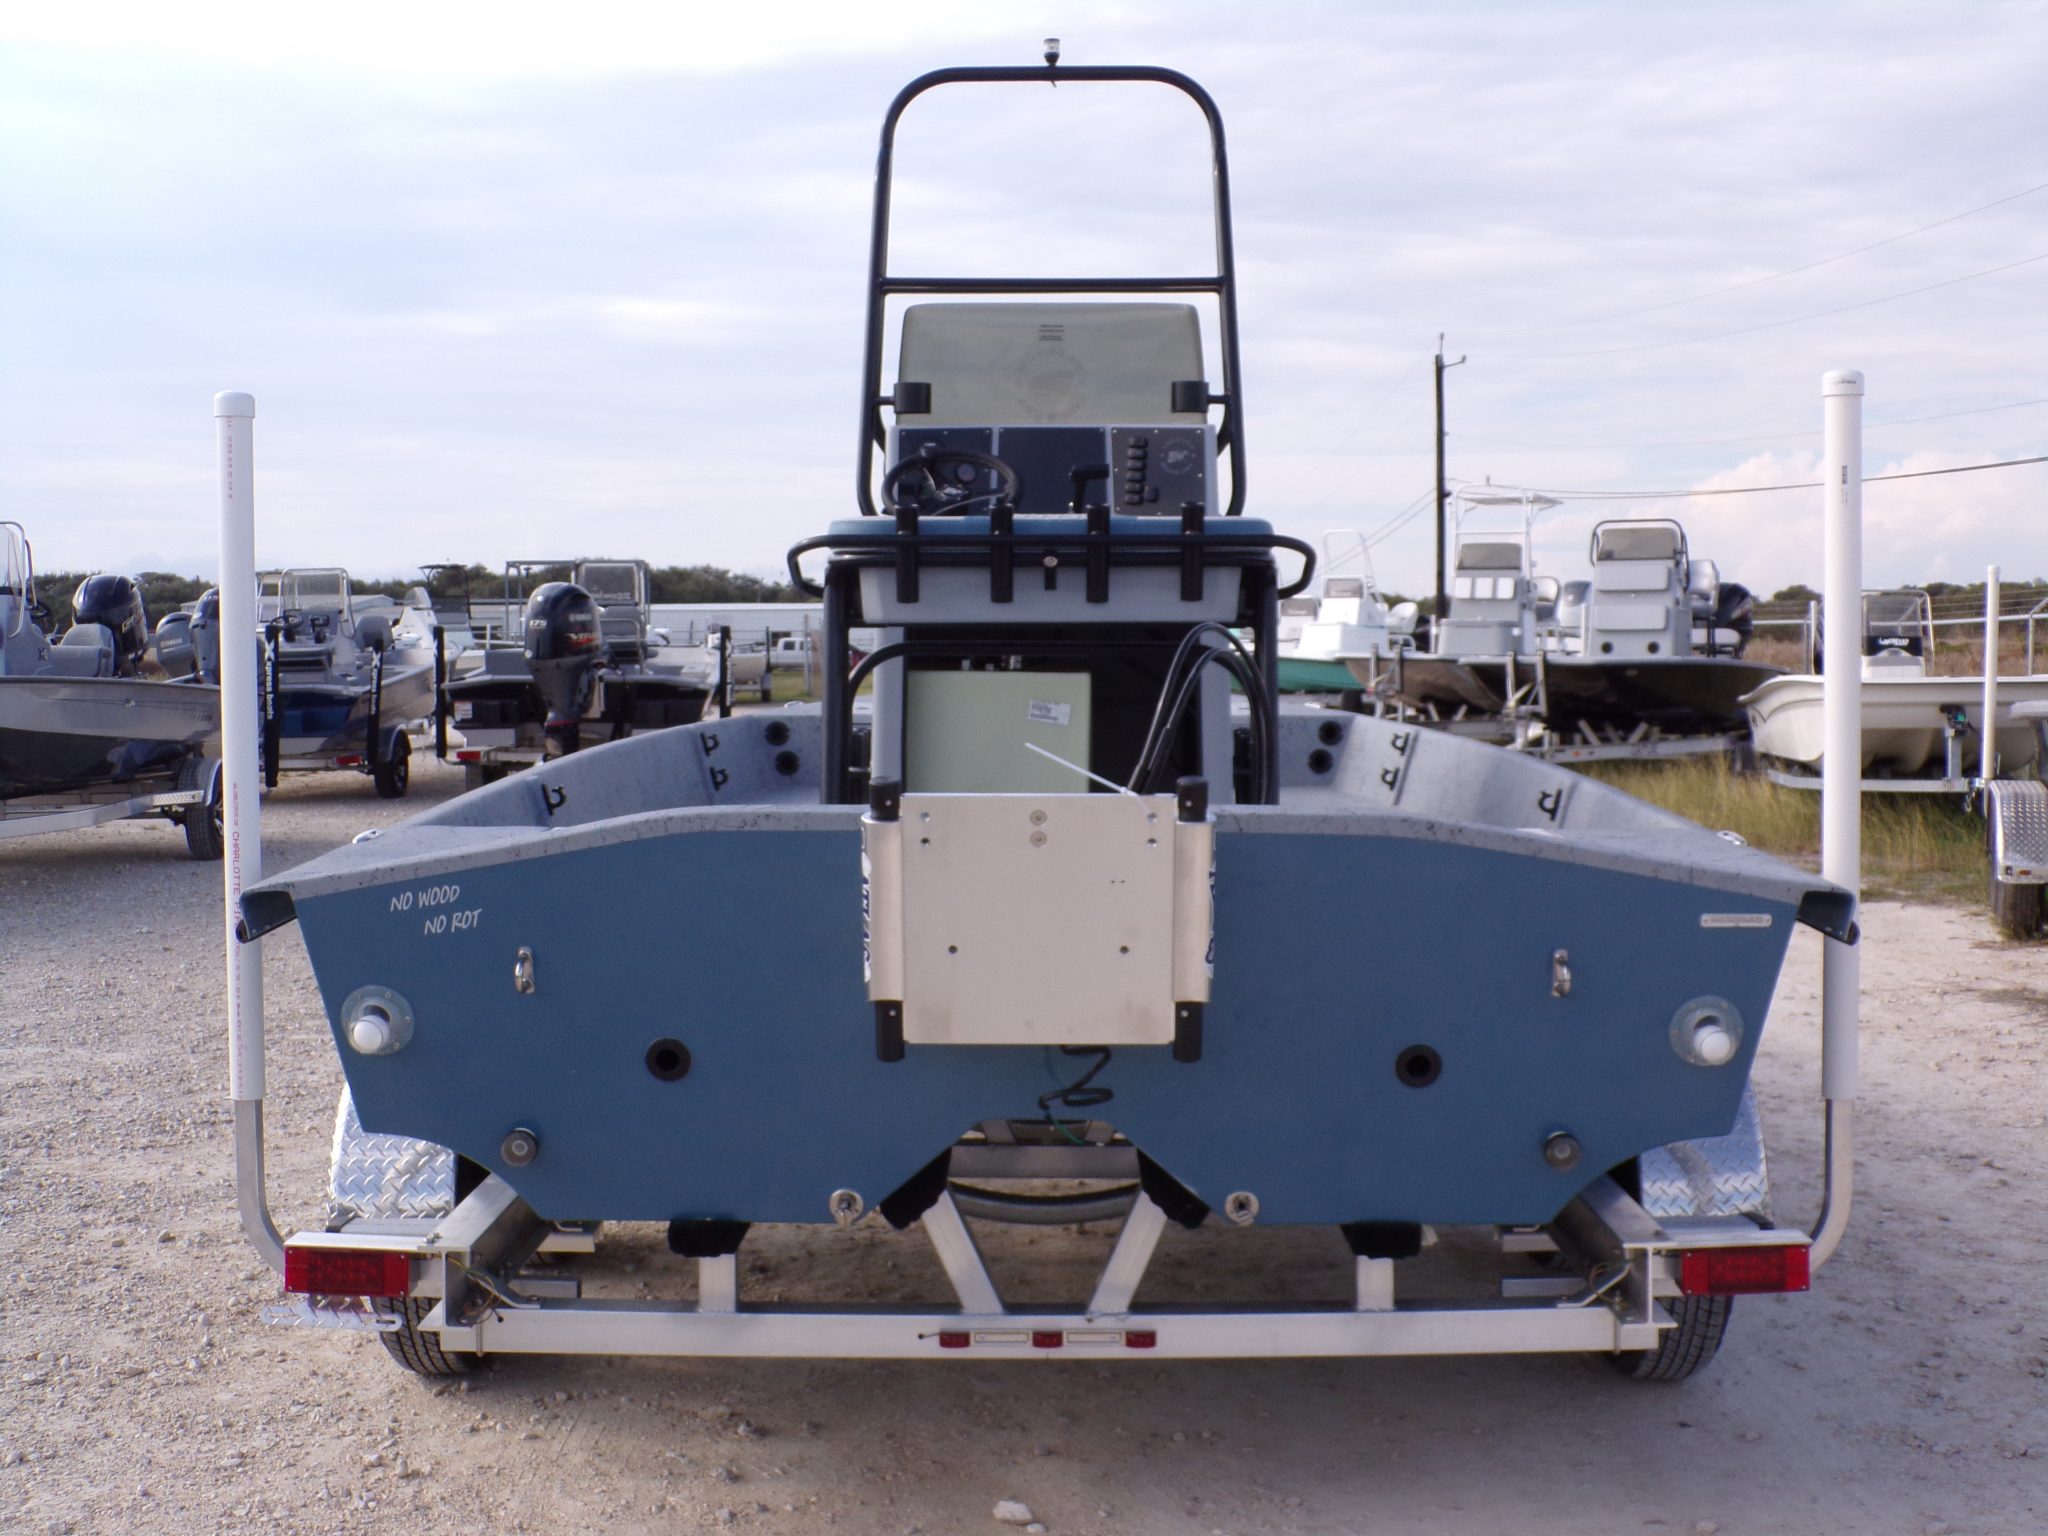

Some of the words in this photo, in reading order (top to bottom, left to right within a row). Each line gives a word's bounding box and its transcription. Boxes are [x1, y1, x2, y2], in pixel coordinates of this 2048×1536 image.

[232, 831, 241, 895] CHARLOTTE
[390, 891, 413, 912] NO
[418, 885, 460, 909] WOOD
[424, 915, 447, 935] NO
[451, 909, 482, 933] ROT
